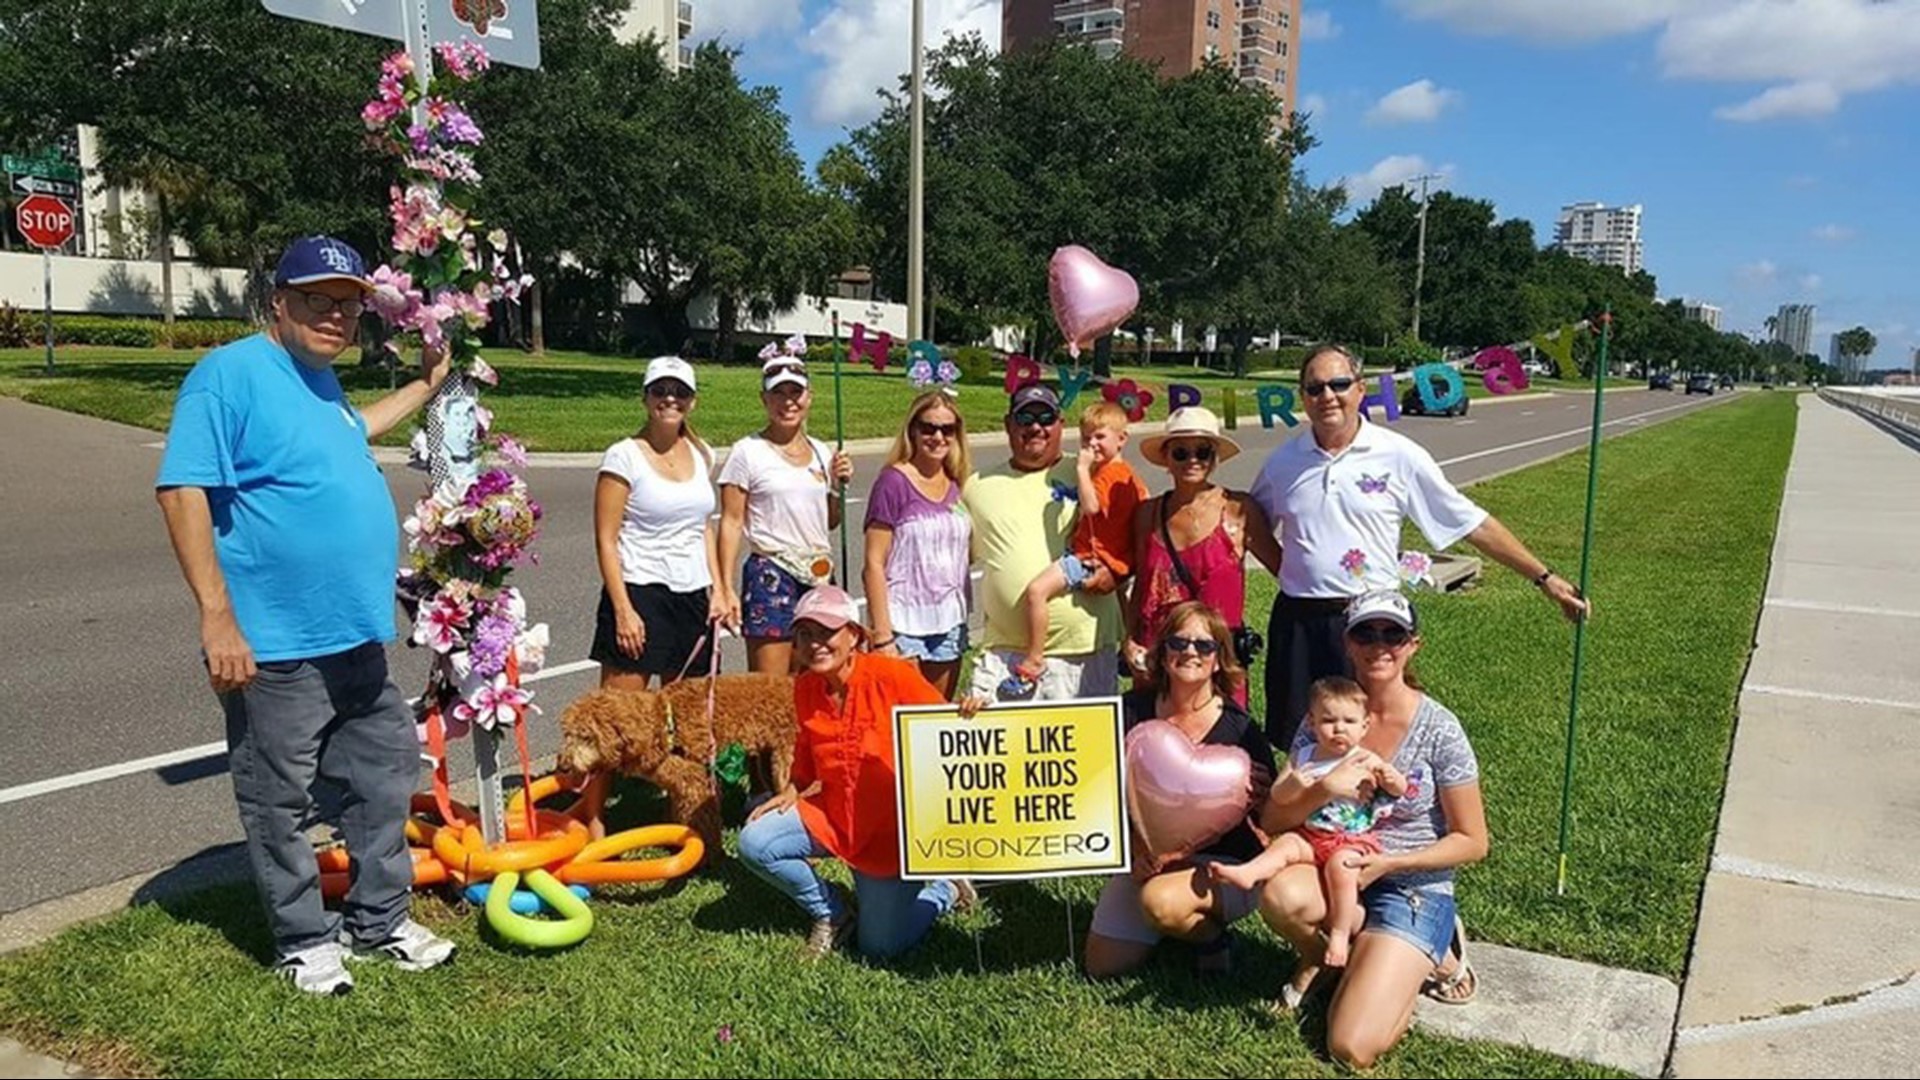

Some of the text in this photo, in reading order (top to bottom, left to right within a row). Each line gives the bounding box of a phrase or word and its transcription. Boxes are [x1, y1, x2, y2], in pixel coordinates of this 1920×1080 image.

[22, 209, 70, 232] STOP
[939, 725, 1077, 757] DRIVE LIKE
[942, 759, 1078, 791] YOUR KIDS
[946, 793, 1077, 825] LIVE HERE
